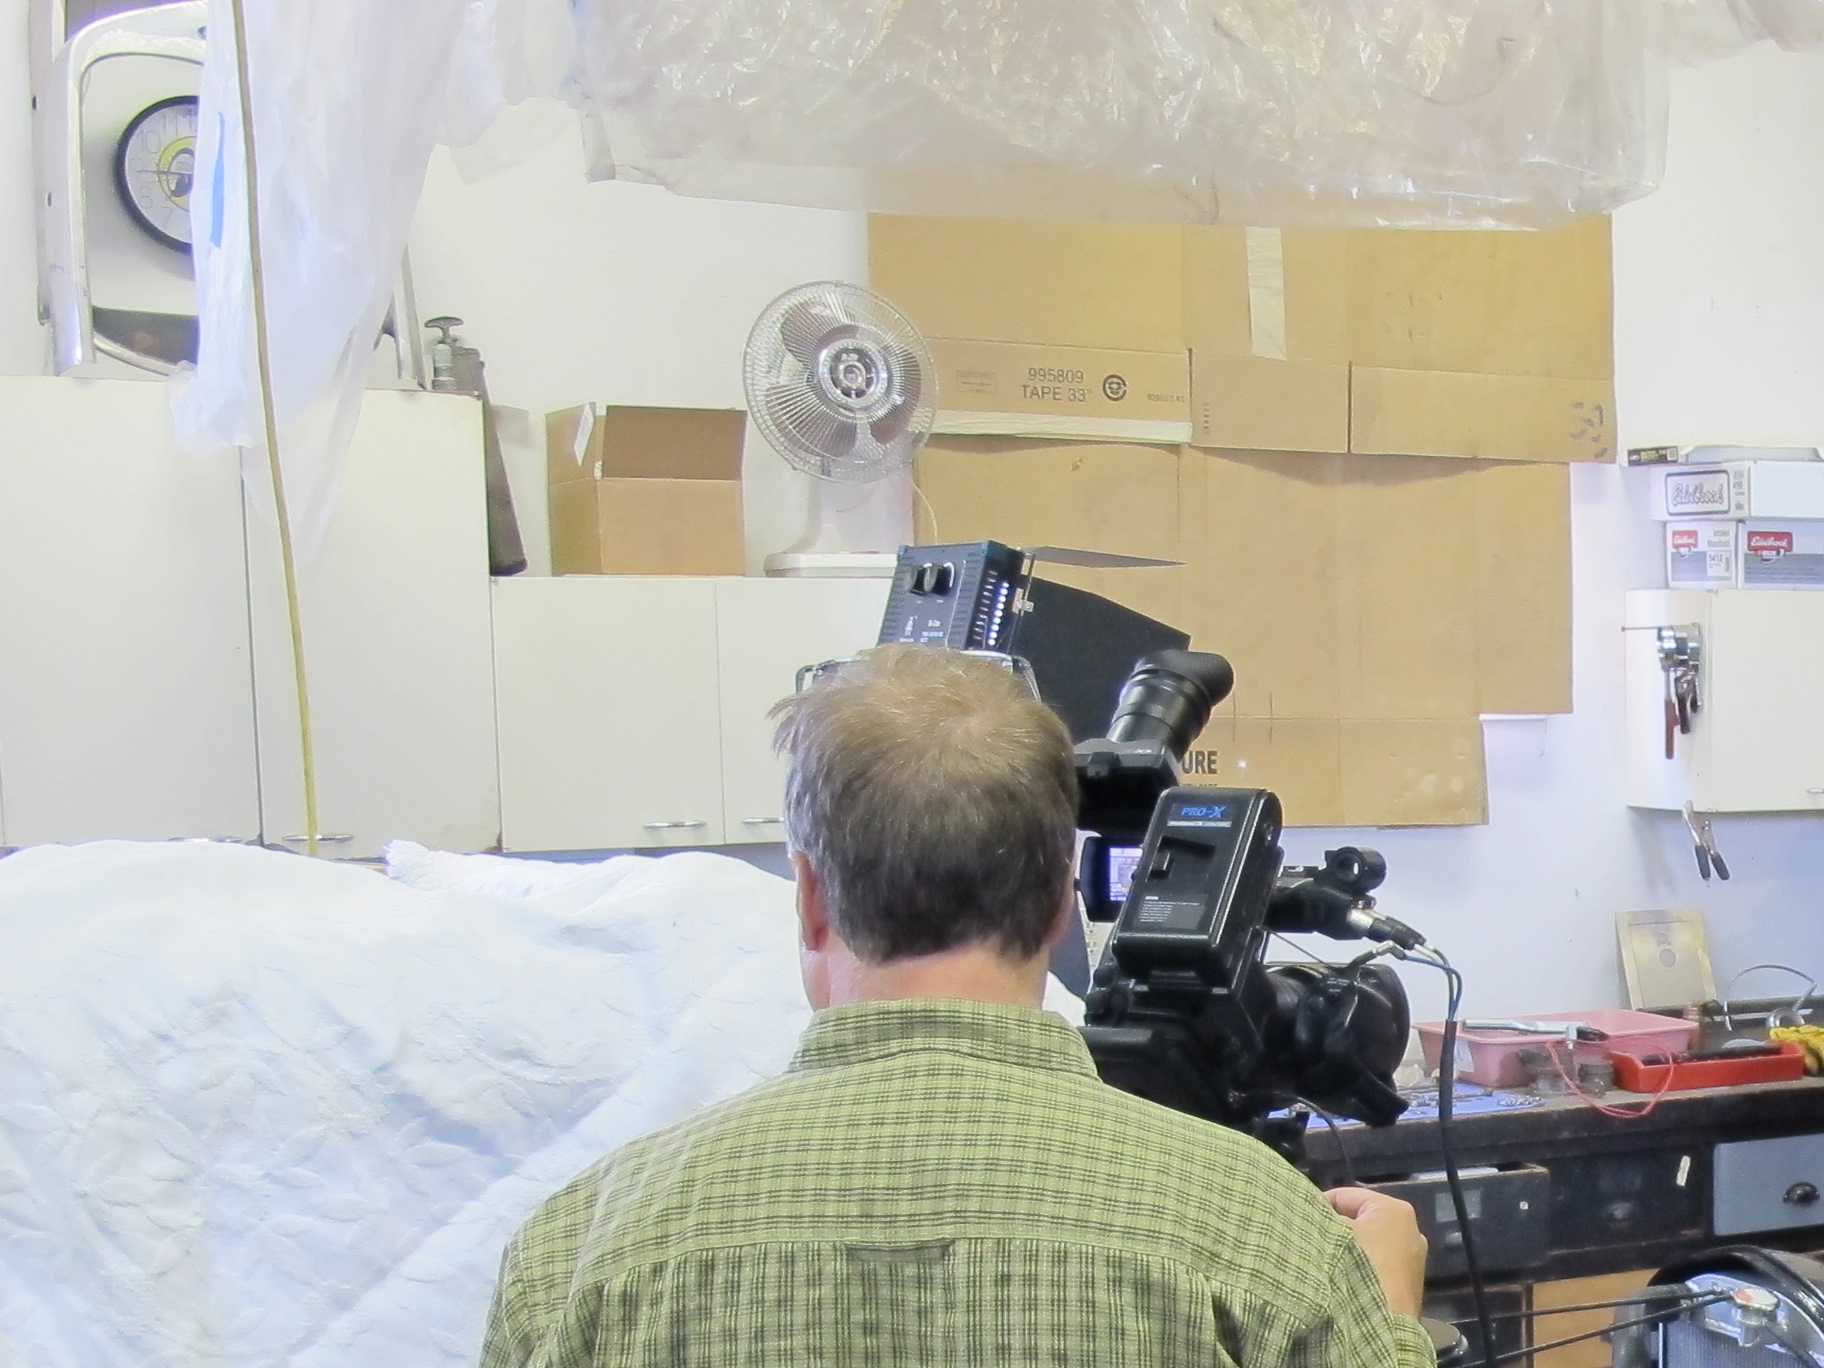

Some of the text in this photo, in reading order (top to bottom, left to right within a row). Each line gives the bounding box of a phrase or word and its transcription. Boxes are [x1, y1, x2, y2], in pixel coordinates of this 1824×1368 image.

[1027, 367, 1084, 384] 995809
[1020, 384, 1063, 401] TAPE
[1180, 805, 1226, 819] PRO-X
